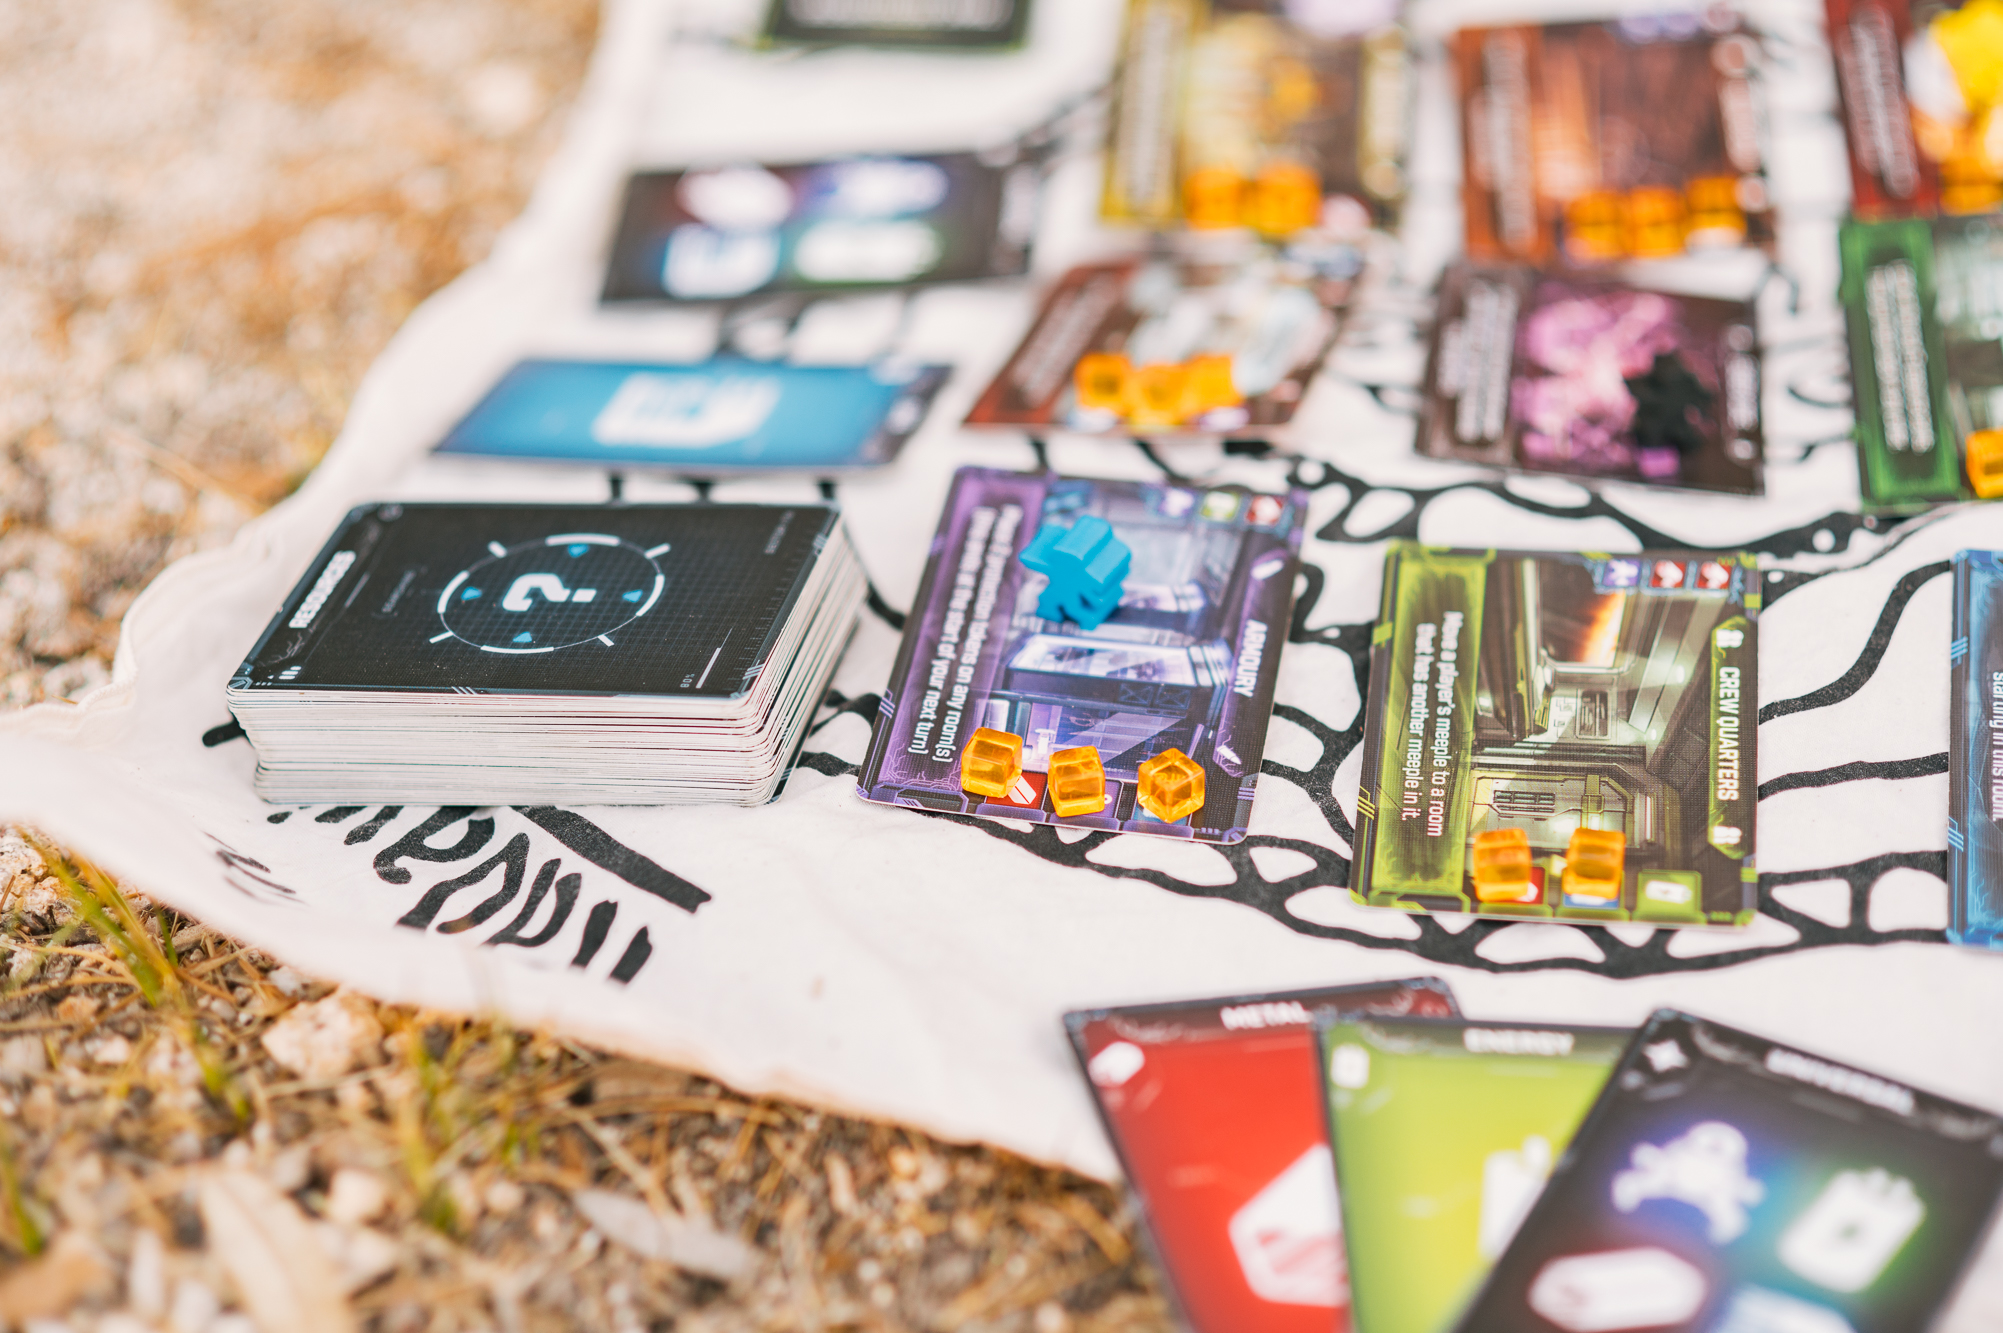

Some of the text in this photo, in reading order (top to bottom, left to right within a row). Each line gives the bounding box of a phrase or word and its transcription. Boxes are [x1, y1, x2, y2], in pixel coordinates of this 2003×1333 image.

[950, 588, 972, 611] the
[942, 610, 964, 643] start
[938, 643, 956, 659] of
[961, 621, 988, 664] tokens
[1233, 619, 1268, 697] ARMOURY
[1441, 650, 1456, 661] a
[679, 673, 695, 688] 80%
[929, 659, 950, 690] your
[957, 666, 974, 683] on
[1435, 662, 1458, 715] player's
[920, 691, 941, 720] next
[947, 685, 968, 709] any
[932, 711, 961, 762] room(s)
[1402, 624, 1436, 820] that has another meeple in it.
[1716, 666, 1741, 801] CREW QUARTERS
[908, 722, 934, 754] turn)
[1430, 718, 1452, 767] meeple
[1431, 788, 1444, 796] a
[1432, 771, 1449, 784] to
[1428, 801, 1444, 836] room
